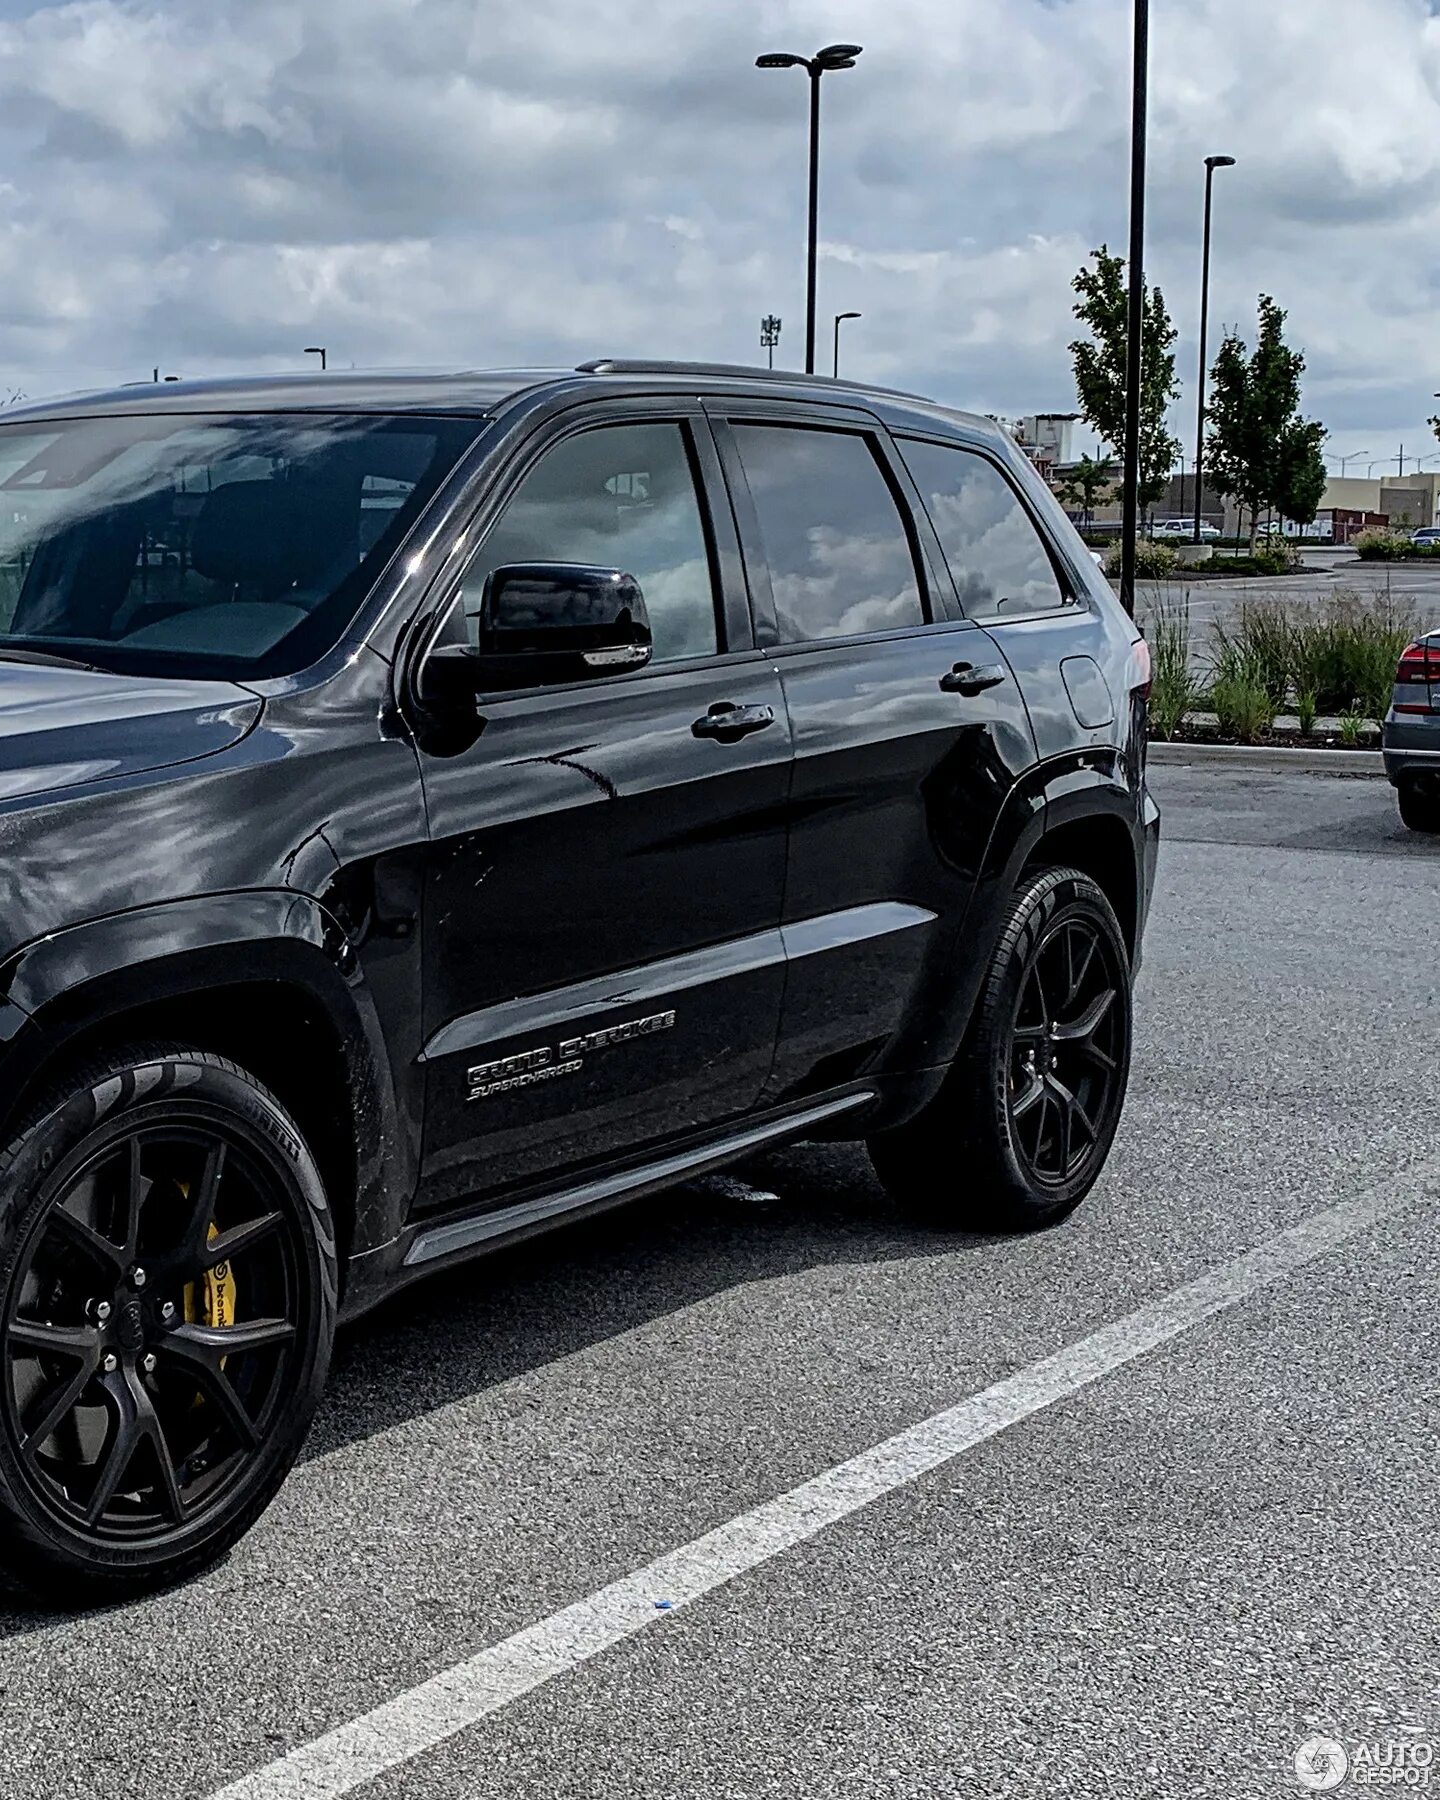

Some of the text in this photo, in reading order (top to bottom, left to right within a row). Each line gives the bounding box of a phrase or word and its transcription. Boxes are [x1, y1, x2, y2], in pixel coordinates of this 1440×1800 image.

[467, 1010, 676, 1086] GRAND CHEROKEE
[467, 1059, 584, 1100] SUPERCHARGED
[216, 1283, 228, 1327] bremb
